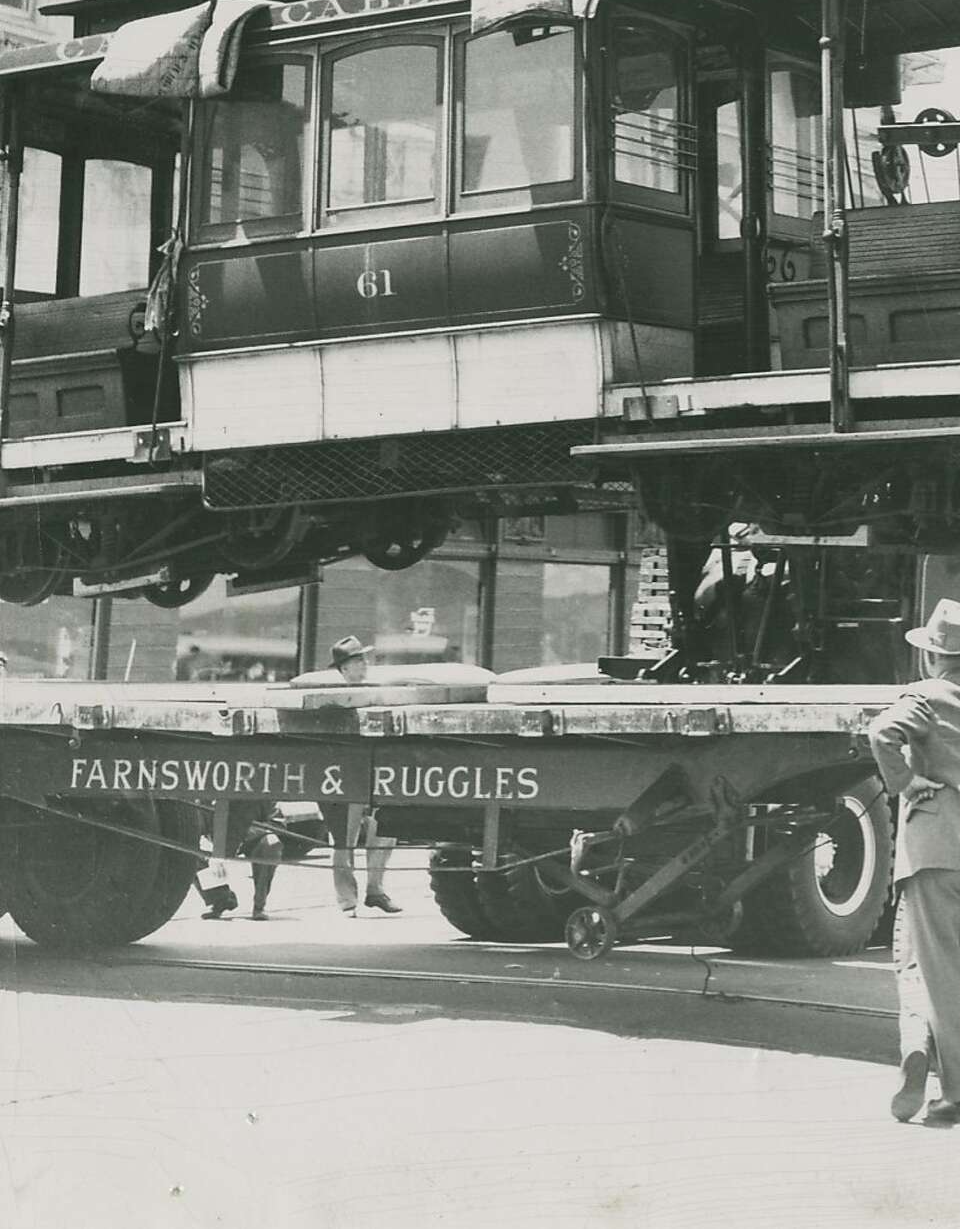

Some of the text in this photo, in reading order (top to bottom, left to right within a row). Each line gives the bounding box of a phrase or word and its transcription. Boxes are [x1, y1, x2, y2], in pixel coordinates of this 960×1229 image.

[357, 269, 397, 298] 61
[70, 758, 539, 799] FARNSWORTH & RUGGLES
